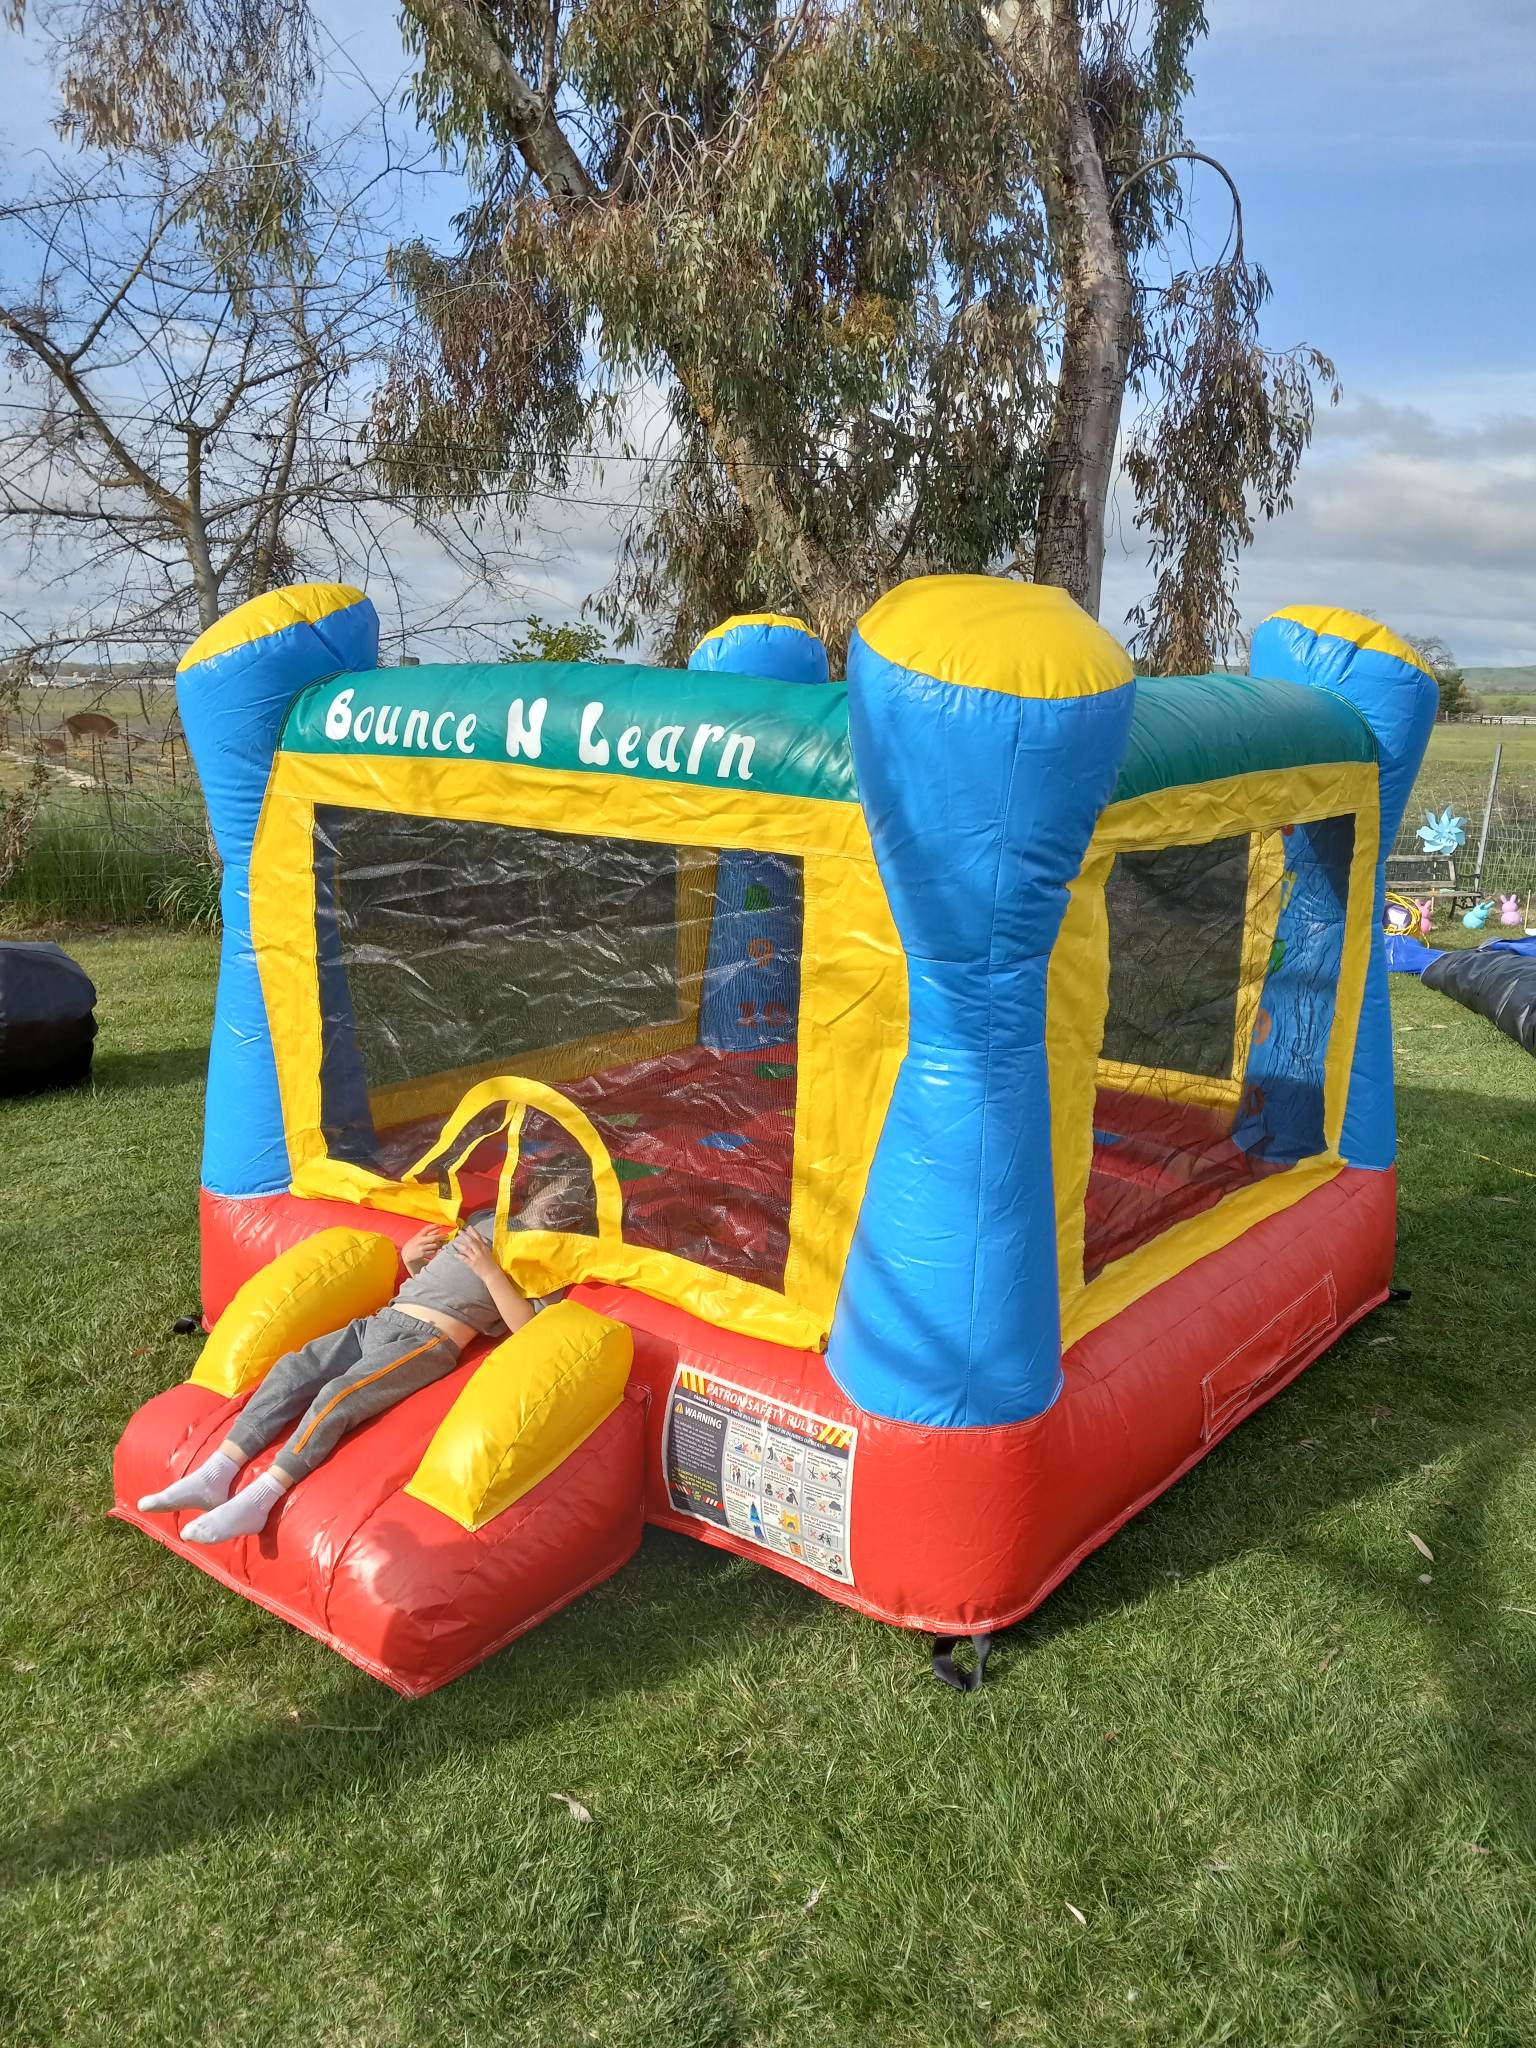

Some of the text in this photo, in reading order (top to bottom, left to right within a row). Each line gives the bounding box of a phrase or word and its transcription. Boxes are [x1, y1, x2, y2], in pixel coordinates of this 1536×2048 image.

[325, 687, 756, 781] Bounce N Learn
[685, 1406, 722, 1430] WARNING
[705, 1382, 747, 1409] PATRON
[746, 1398, 786, 1422] SAFETY
